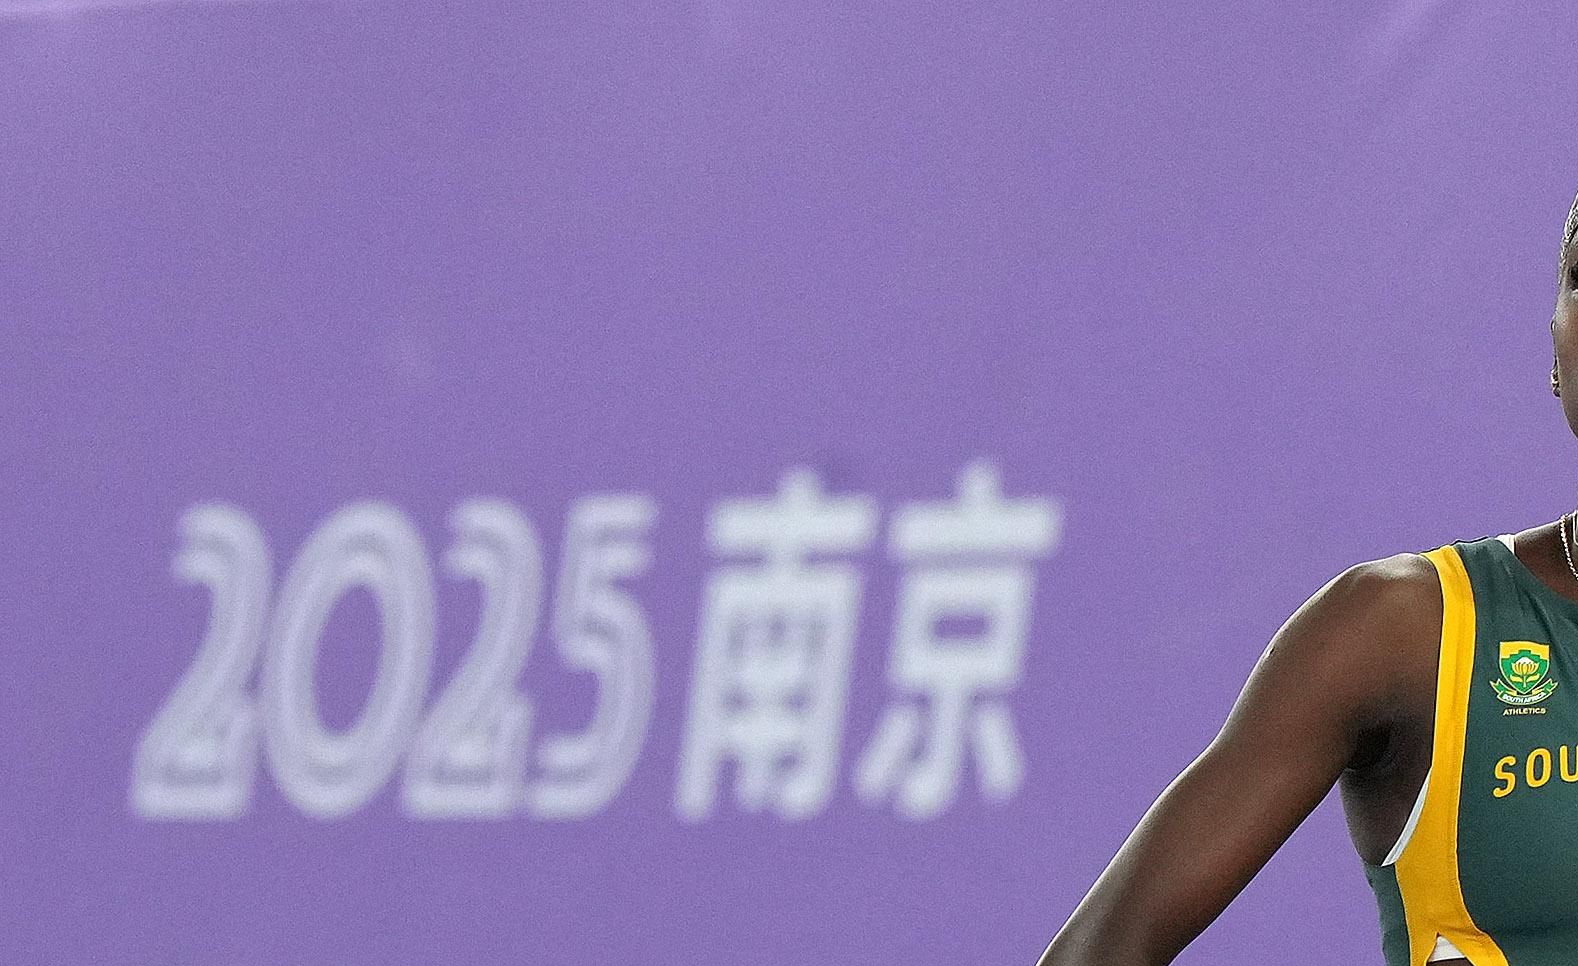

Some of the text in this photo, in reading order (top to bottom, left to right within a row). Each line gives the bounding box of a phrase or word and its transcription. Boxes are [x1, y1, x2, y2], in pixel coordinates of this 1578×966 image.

[130, 460, 1064, 822] 2025 南京
[1503, 707, 1546, 716] ATHLETICS
